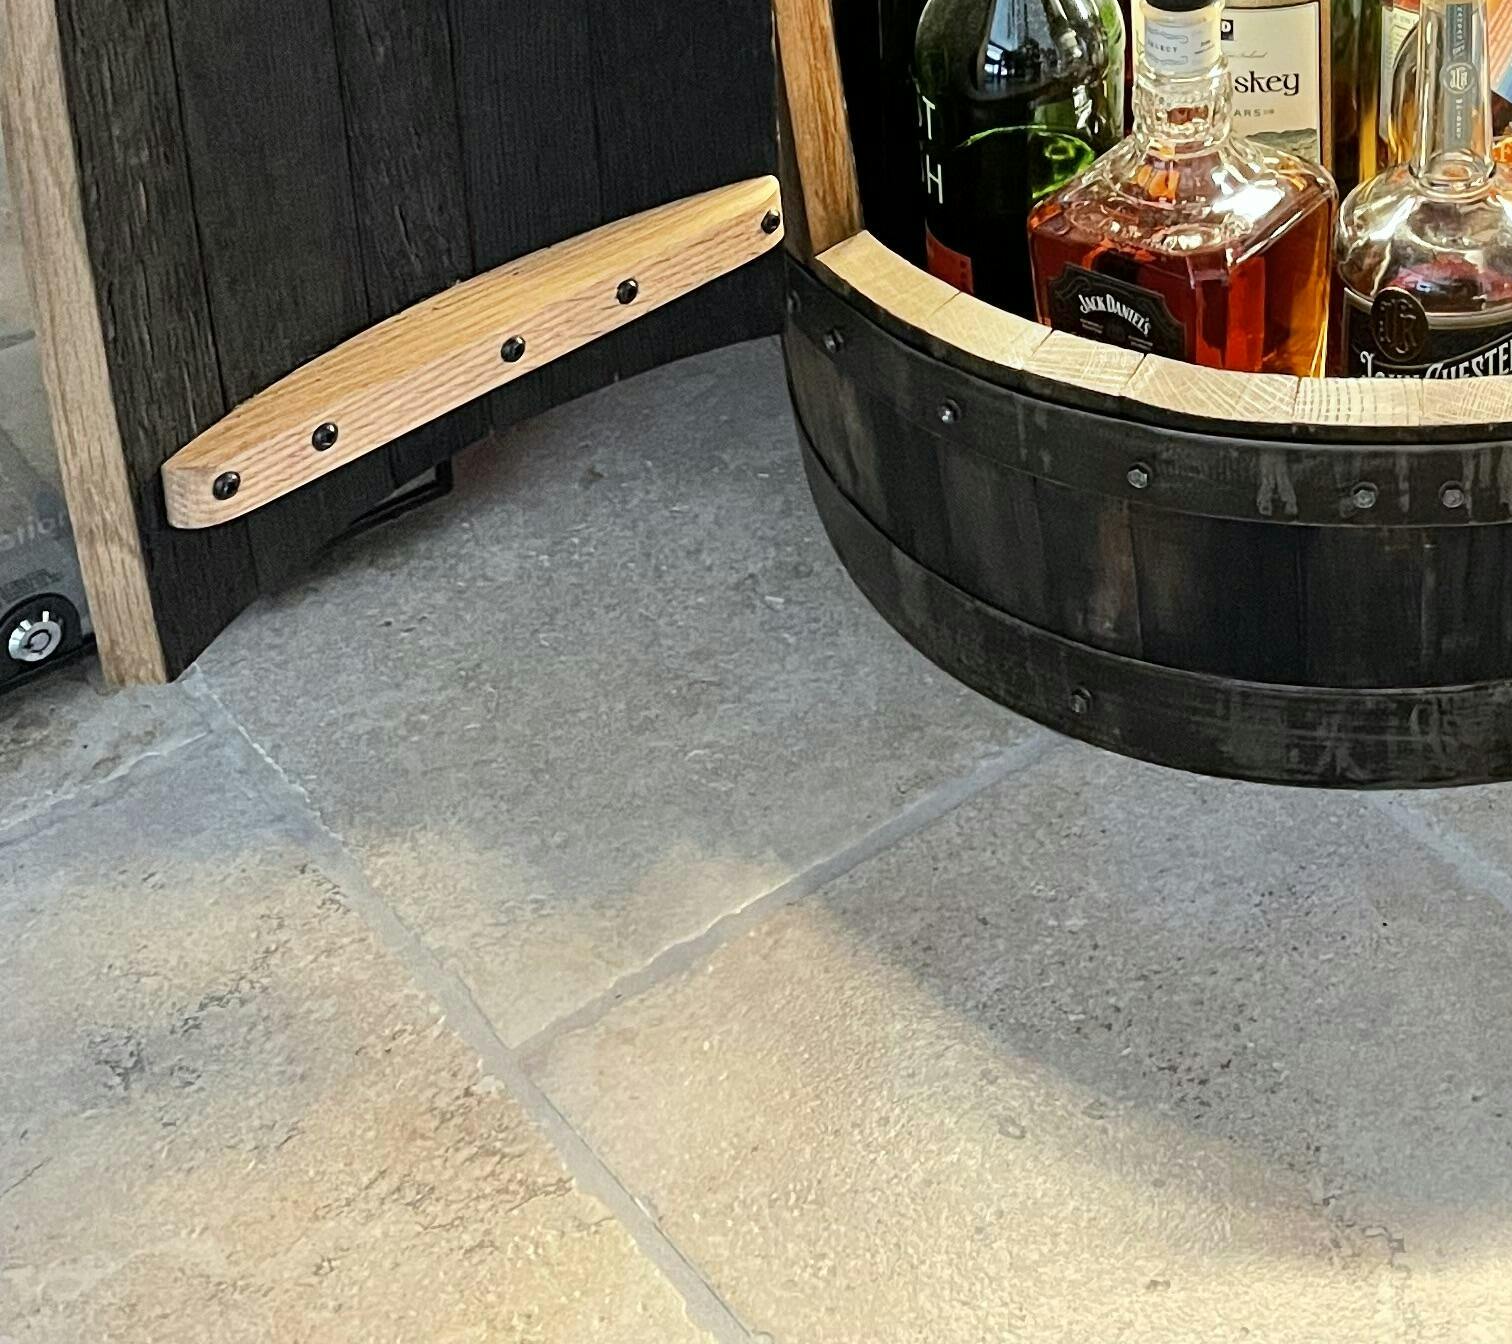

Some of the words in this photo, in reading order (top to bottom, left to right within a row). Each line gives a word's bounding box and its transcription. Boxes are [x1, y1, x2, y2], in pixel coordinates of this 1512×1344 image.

[1234, 70, 1300, 97] skey
[1233, 108, 1262, 118] ARS
[1078, 294, 1107, 314] JACK
[1106, 293, 1152, 337] DANIEL'S
